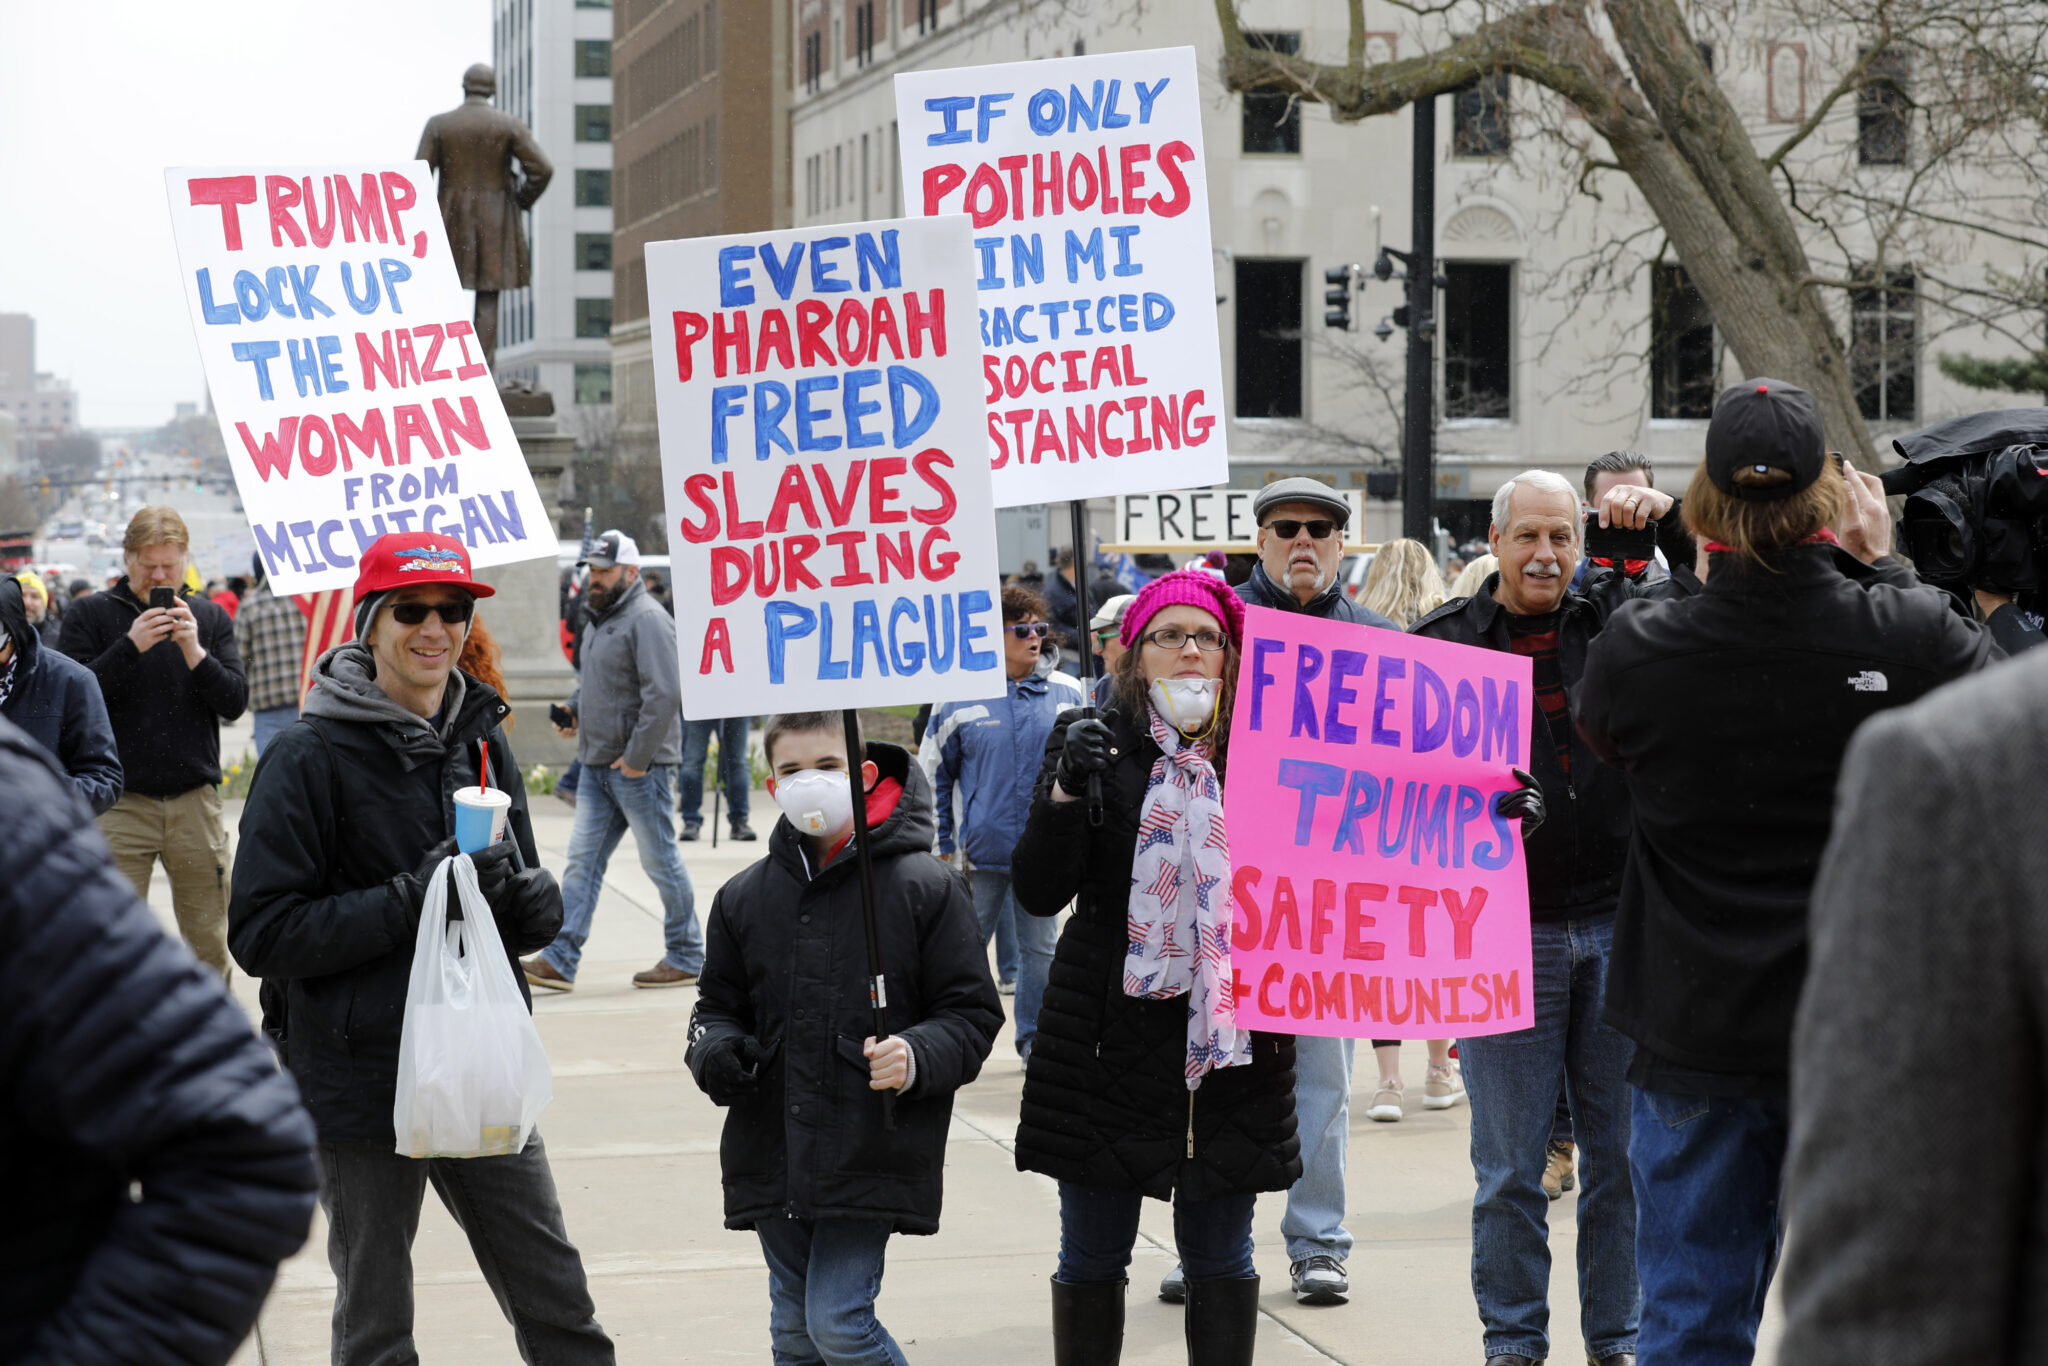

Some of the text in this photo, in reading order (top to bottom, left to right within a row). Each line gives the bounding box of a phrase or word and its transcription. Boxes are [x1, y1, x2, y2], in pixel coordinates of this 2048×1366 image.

[925, 78, 1170, 146] IF ONLY
[188, 172, 427, 258] TRUMP,
[923, 141, 1195, 228] POTHOLES
[196, 259, 411, 325] LOCK UP
[718, 229, 900, 308] EVEN
[975, 225, 1143, 290] IN MI
[232, 321, 487, 401] THE NAZI
[673, 288, 946, 382] PHAROAH
[980, 292, 1175, 347] RACTICED
[712, 365, 941, 464] FREED
[983, 344, 1147, 404] SOCIAL
[235, 396, 491, 482] WOMAN
[988, 390, 1215, 470] STANCING
[344, 463, 459, 510] FROM
[681, 448, 957, 543] SLAVES
[710, 527, 960, 606] DURING
[700, 590, 998, 684] A PLAGUE
[1249, 637, 1519, 765] FREEDOM
[1278, 758, 1515, 870] TRUMPS
[1231, 865, 1489, 960] SAFETY
